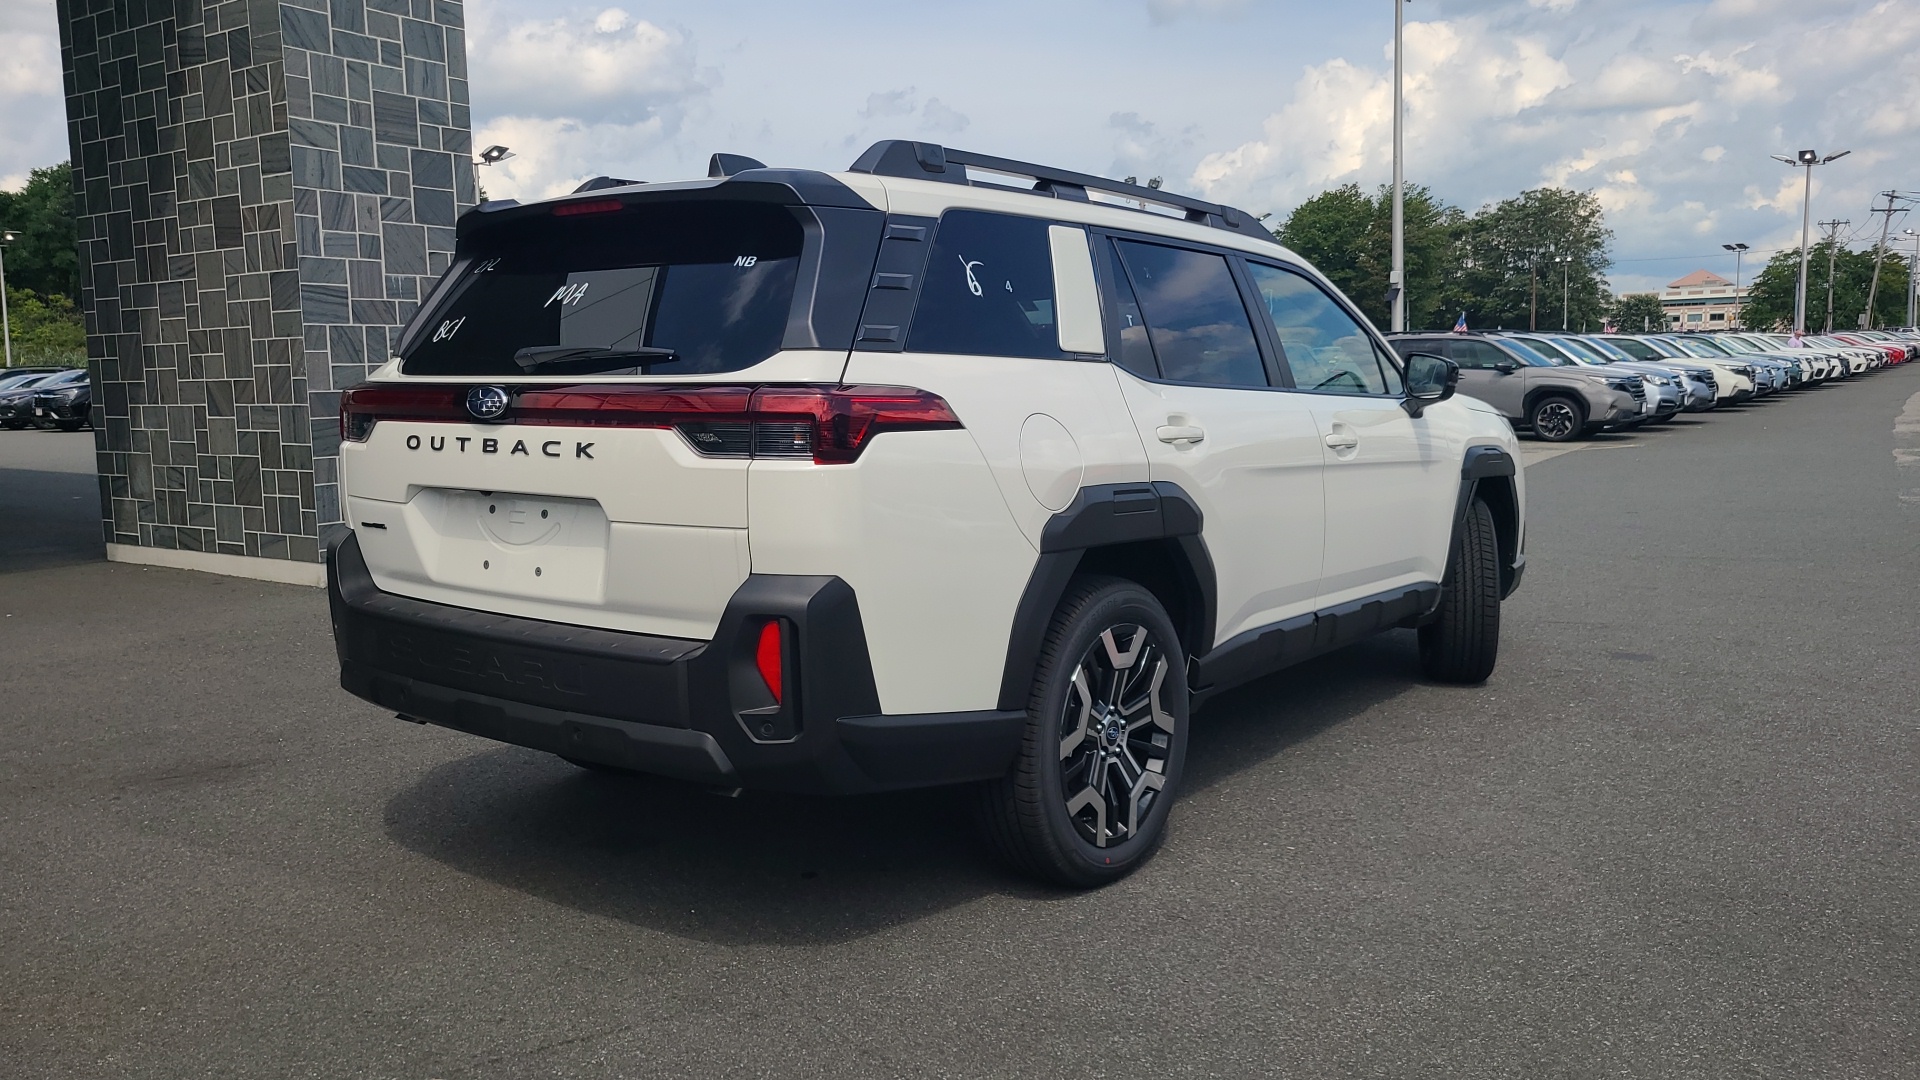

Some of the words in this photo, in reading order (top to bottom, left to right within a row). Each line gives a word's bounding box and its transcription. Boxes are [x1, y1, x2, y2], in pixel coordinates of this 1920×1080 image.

[733, 255, 757, 267] NB
[543, 282, 589, 308] MA
[406, 434, 596, 459] OUTBACK
[389, 636, 586, 695] SUBARU
